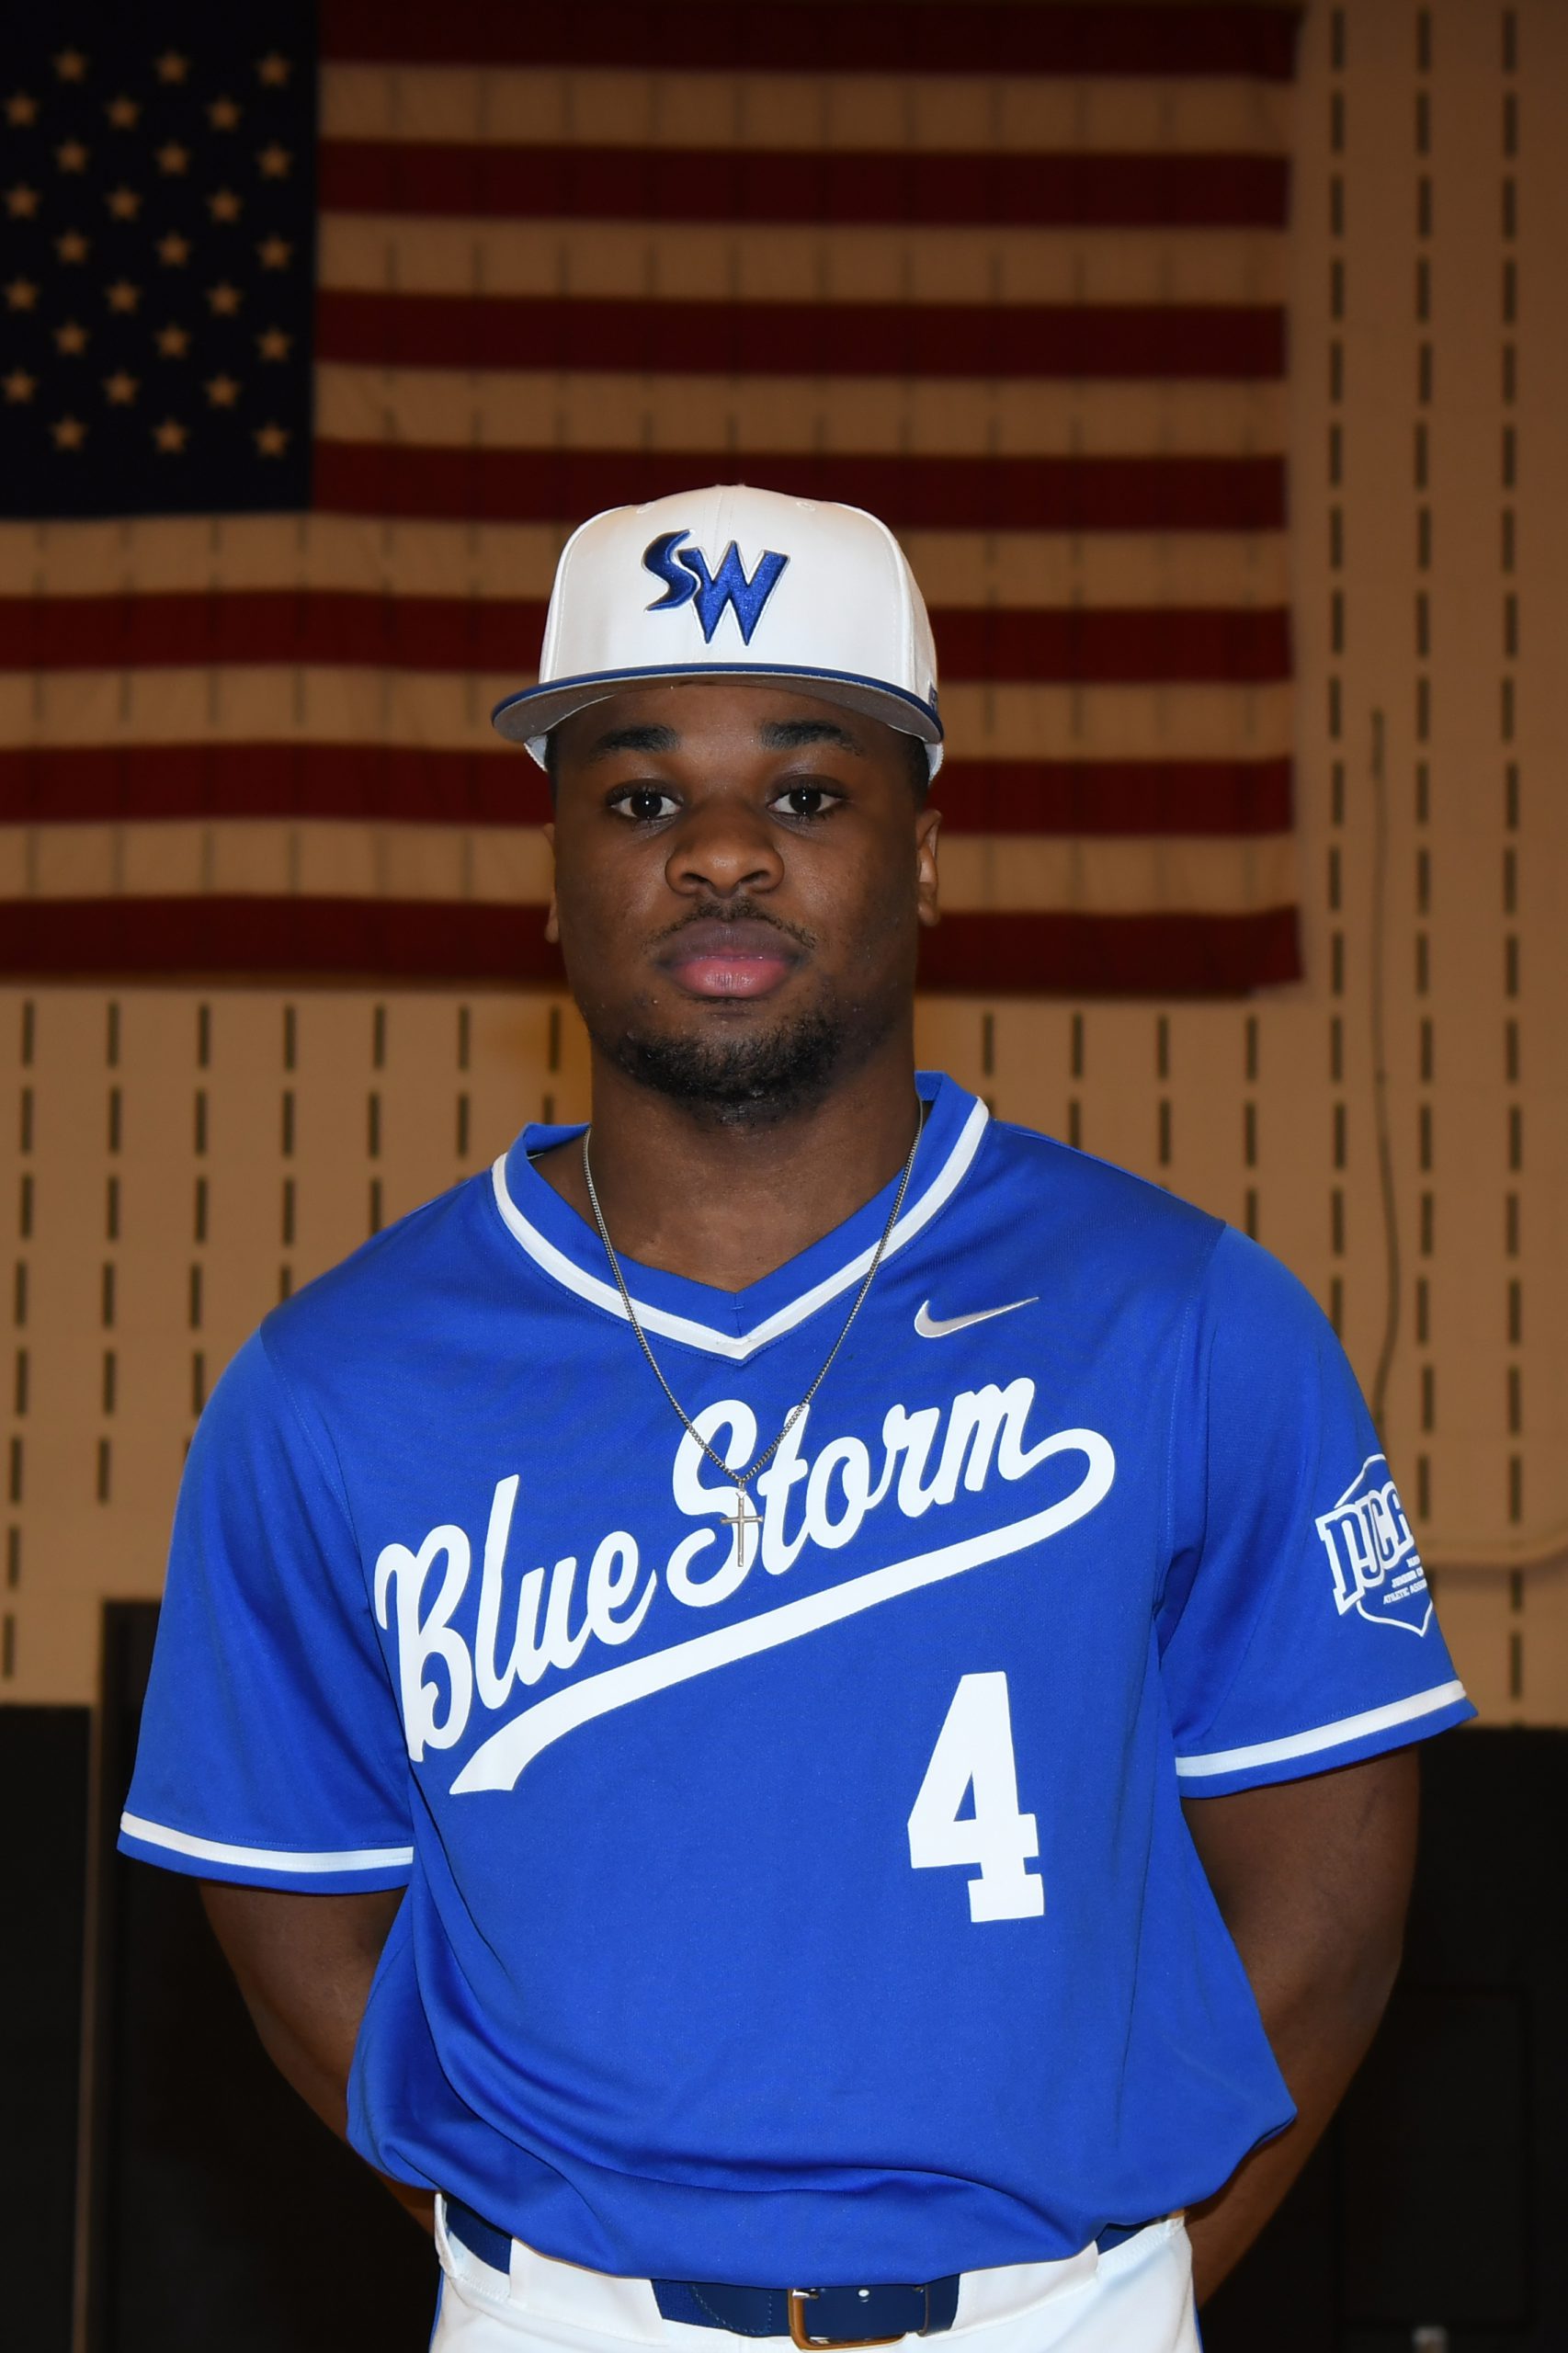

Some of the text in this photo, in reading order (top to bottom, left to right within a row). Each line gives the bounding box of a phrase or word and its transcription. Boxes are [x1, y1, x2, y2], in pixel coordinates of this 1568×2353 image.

[642, 529, 790, 646] SW
[375, 1378, 1037, 1762] Blue Storm
[907, 1671, 1044, 1922] 4
